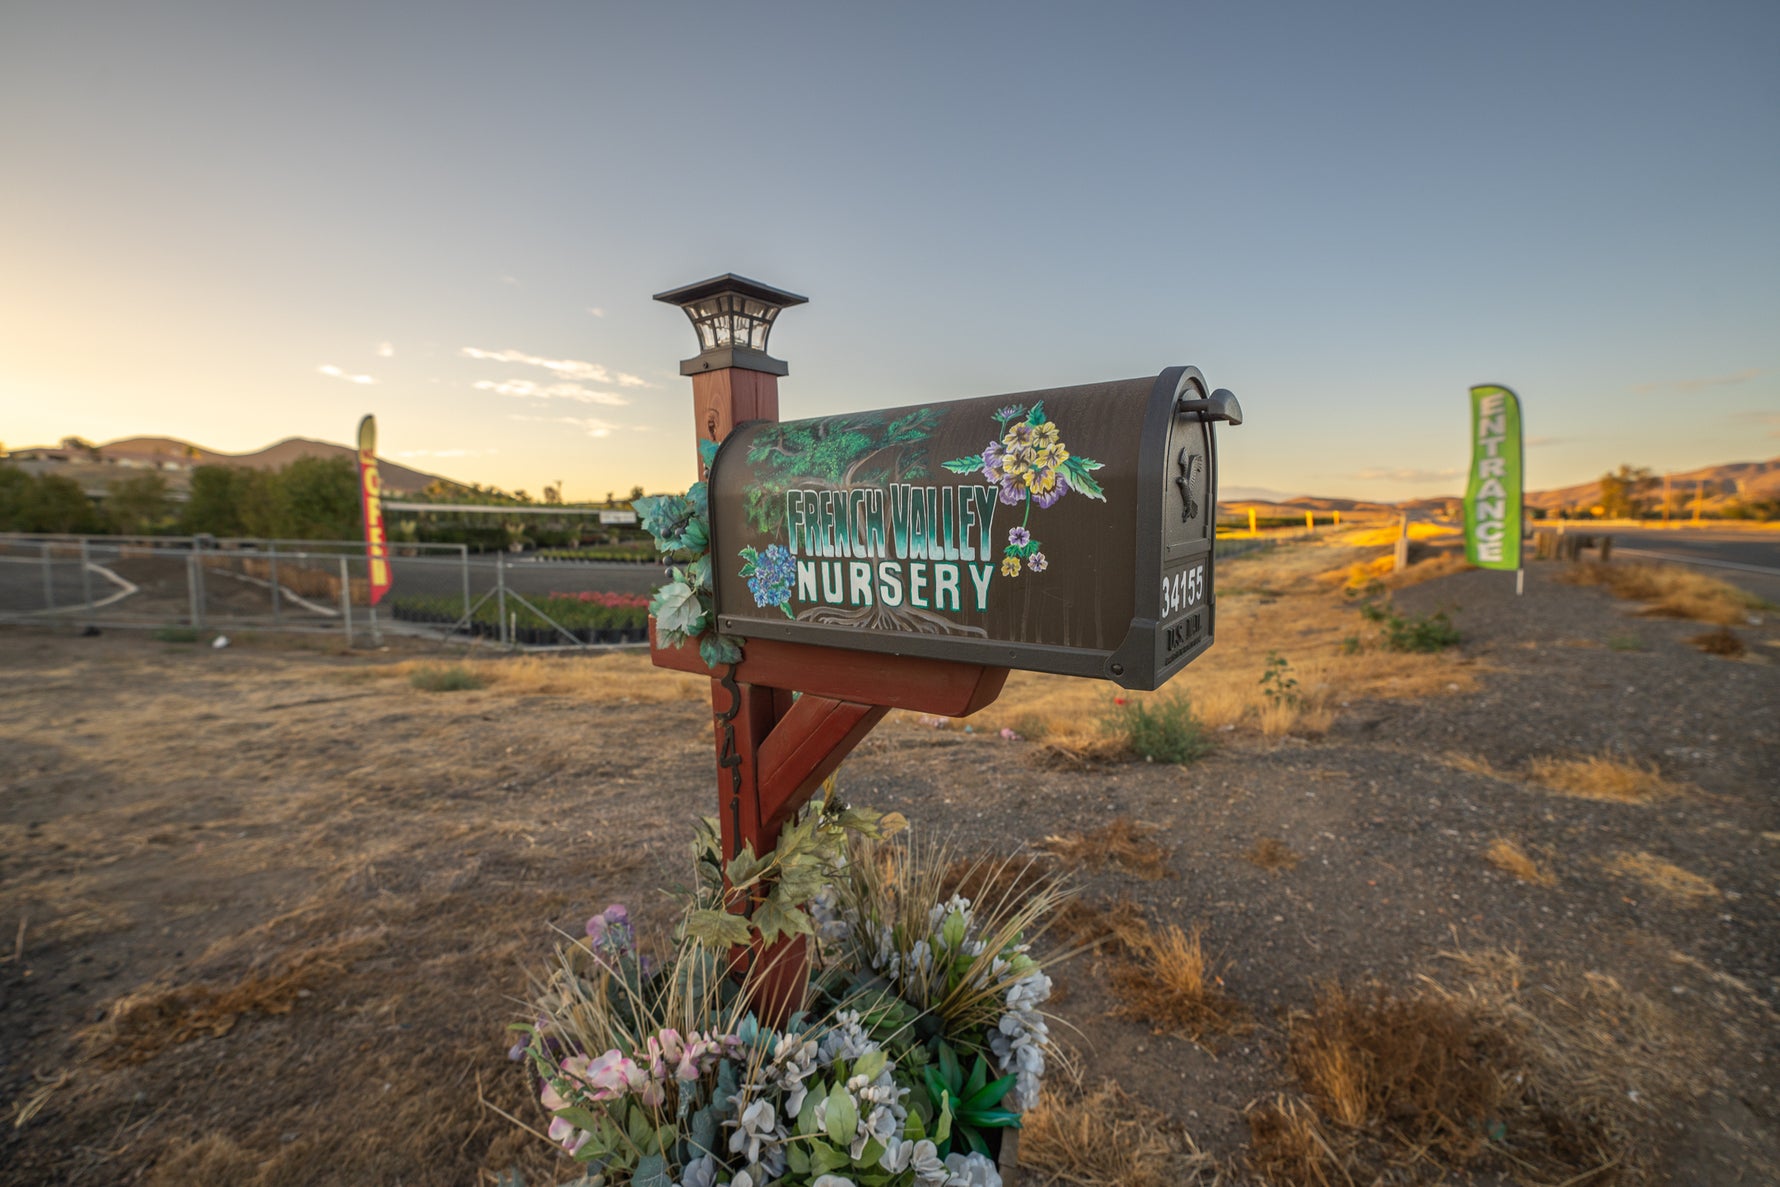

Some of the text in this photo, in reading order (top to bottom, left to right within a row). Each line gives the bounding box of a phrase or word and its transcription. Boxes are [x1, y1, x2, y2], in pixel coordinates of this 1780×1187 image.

[1475, 393, 1506, 562] ENTRANCE
[787, 483, 999, 562] FRENCH VALLEY
[797, 559, 995, 612] NURSERY
[1161, 565, 1203, 618] 34155
